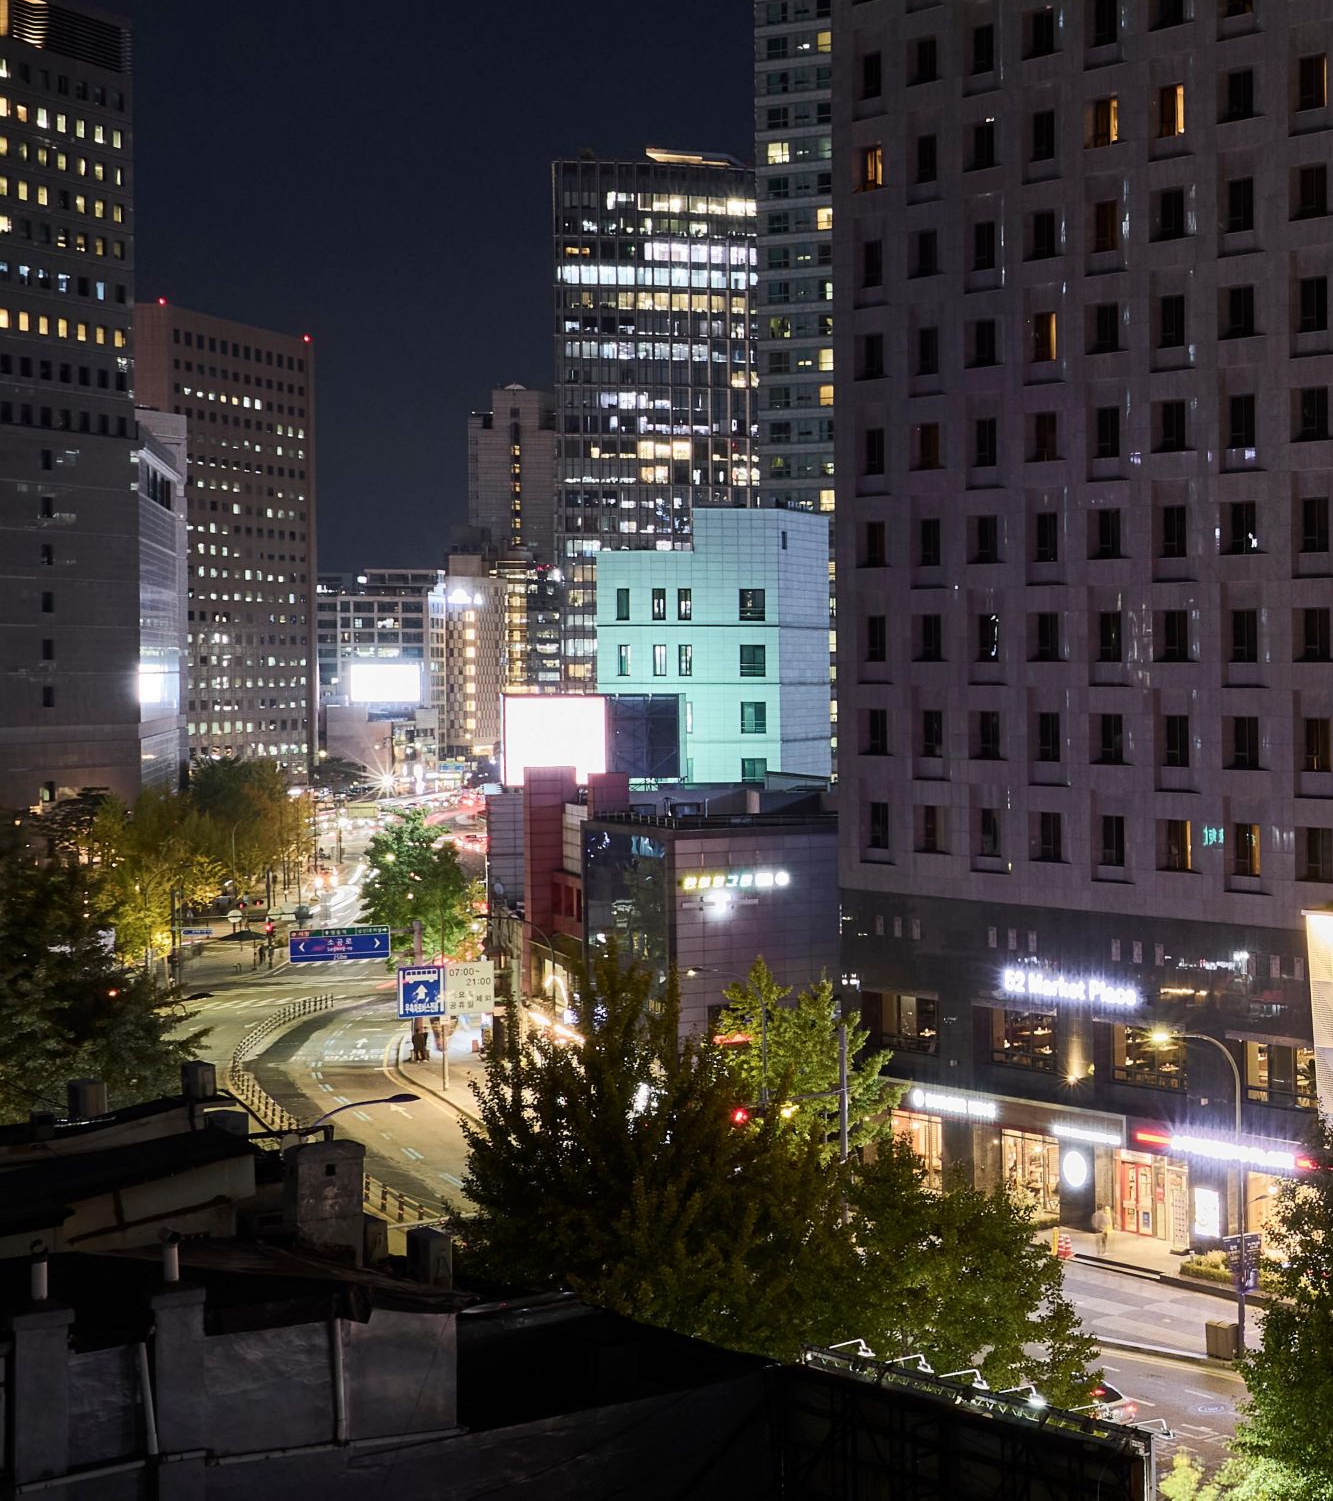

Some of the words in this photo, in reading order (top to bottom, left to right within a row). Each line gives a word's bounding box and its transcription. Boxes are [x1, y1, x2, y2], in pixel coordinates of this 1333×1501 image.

[327, 938, 353, 947] 소공로
[466, 977, 491, 986] 21:00
[1028, 972, 1086, 1001] Market
[1088, 978, 1137, 1006] Place
